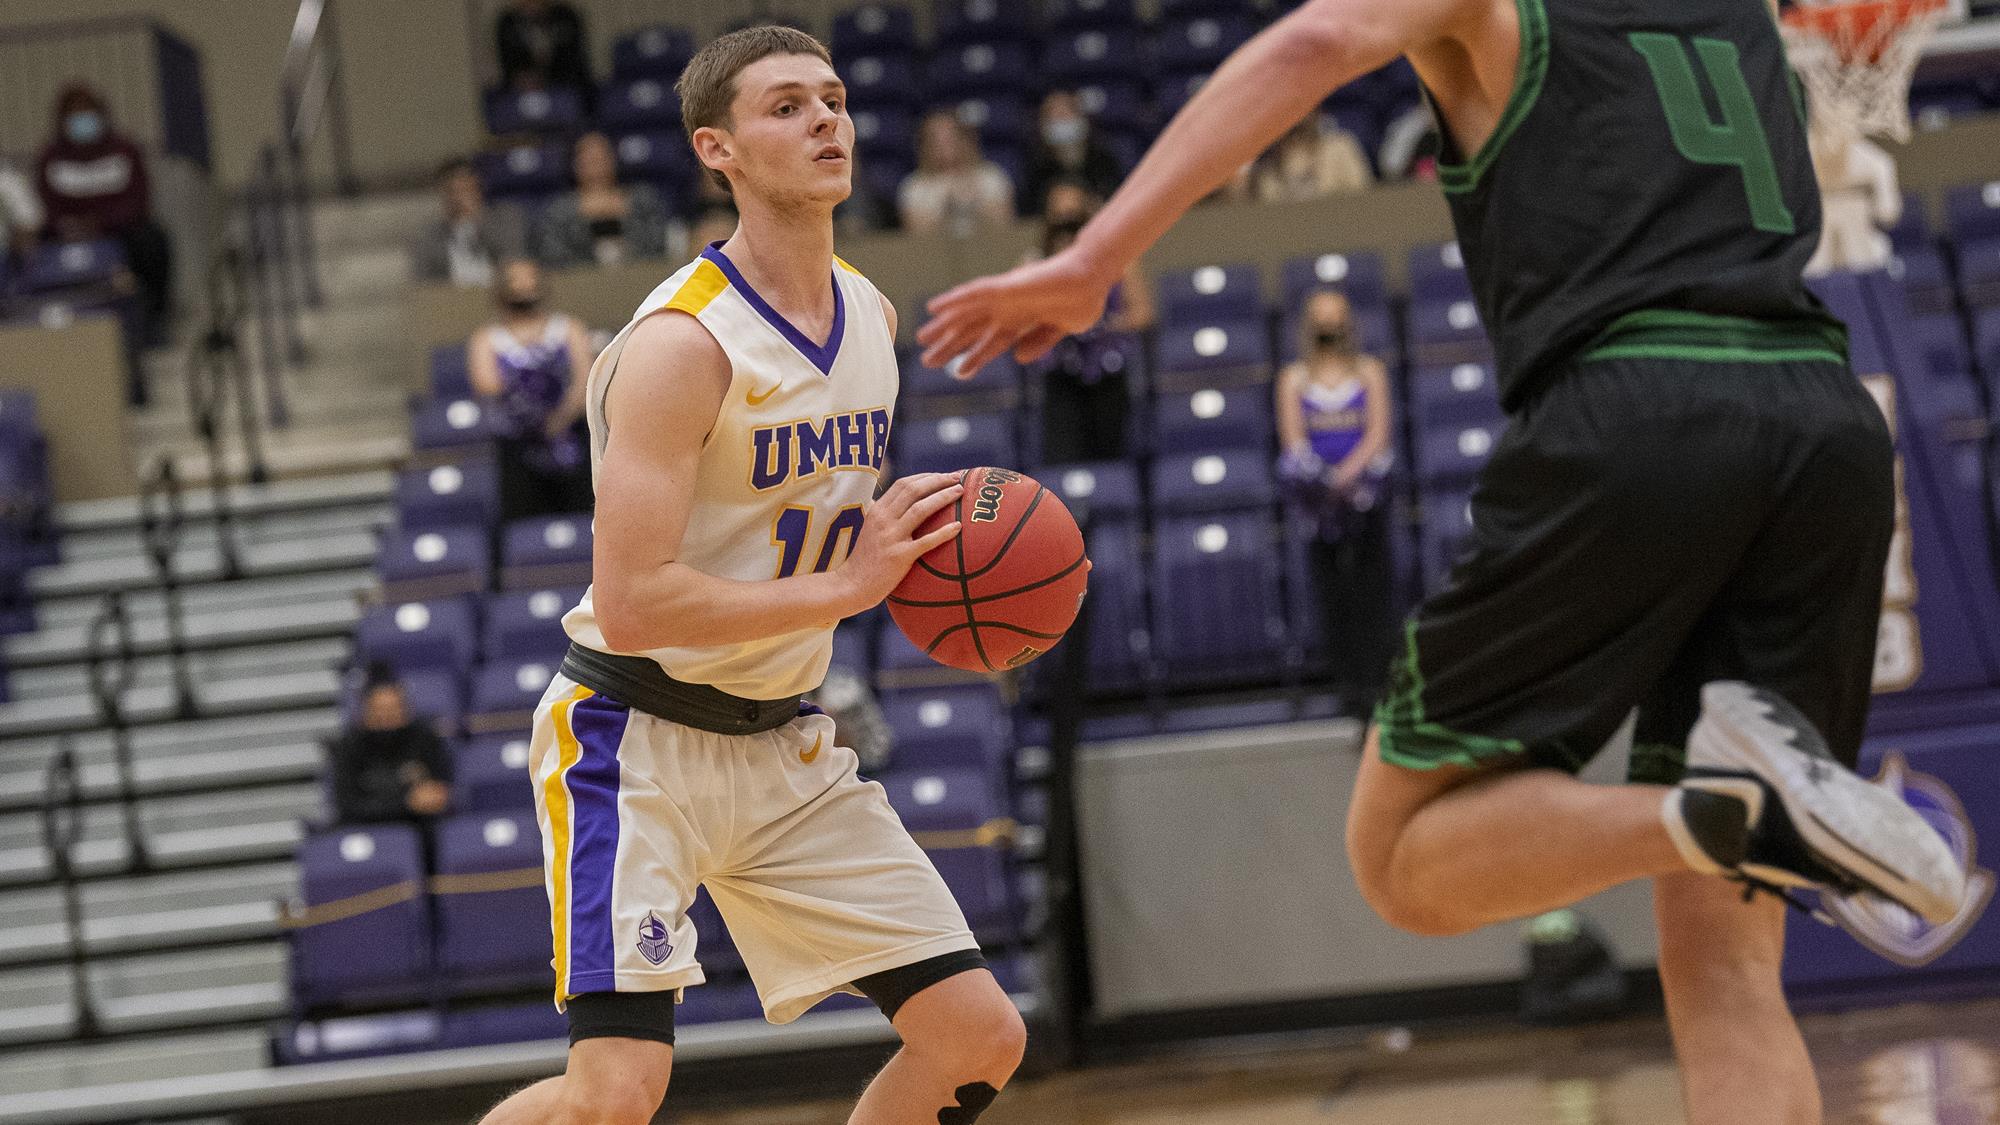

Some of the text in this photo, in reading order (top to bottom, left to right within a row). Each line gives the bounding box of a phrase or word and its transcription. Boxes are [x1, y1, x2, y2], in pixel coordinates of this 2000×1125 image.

[1627, 31, 1796, 235] 4
[750, 407, 889, 492] UMHB
[771, 503, 866, 579] 10
